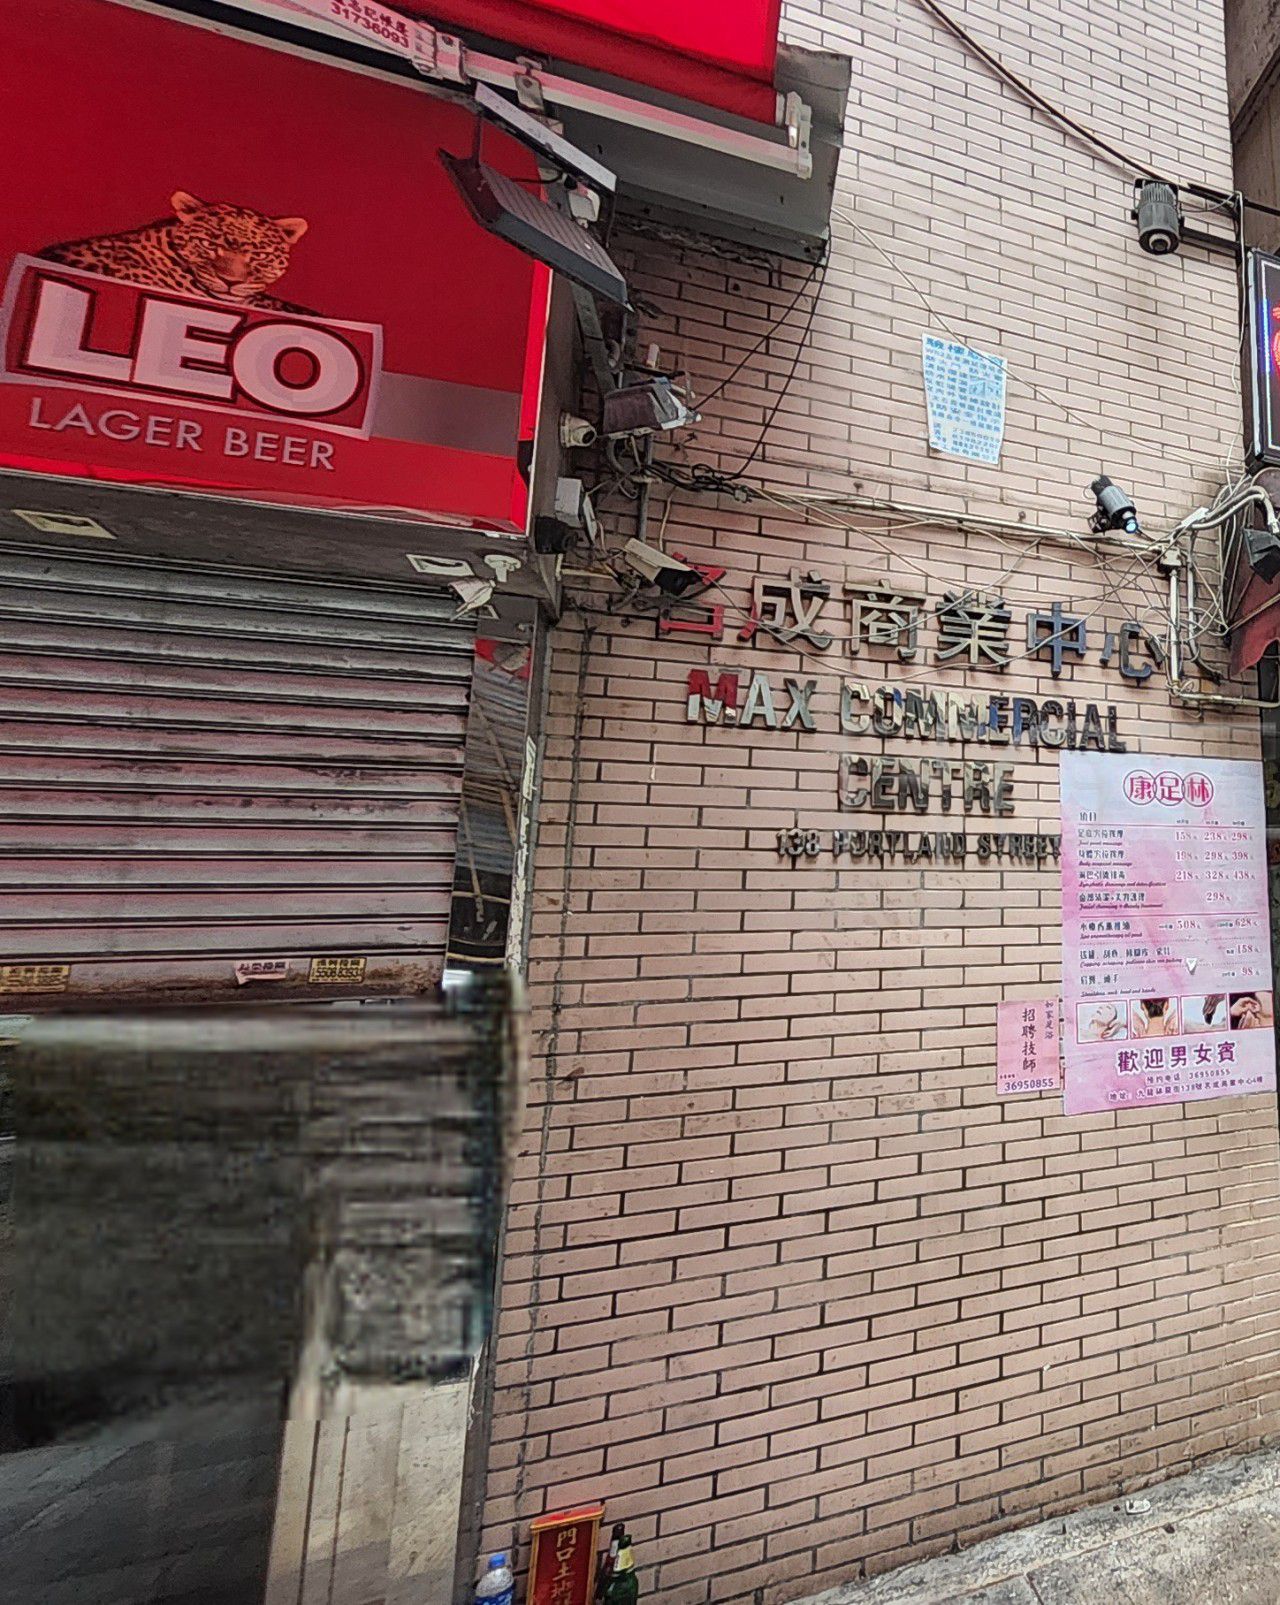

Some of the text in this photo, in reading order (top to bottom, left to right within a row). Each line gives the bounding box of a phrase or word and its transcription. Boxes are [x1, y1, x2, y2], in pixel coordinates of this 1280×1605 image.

[25, 278, 364, 416] LEO
[29, 397, 335, 471] LAGER BEER
[686, 668, 1127, 753] MAX COMMERCIAL
[838, 753, 1017, 815] CENTRE
[1128, 775, 1210, 803] 康足林
[775, 828, 821, 858] 138
[832, 829, 968, 861] PORTLAND
[1021, 1007, 1037, 1073] 招聘技師
[1117, 1040, 1237, 1074] 歡迎男女賓
[1004, 1077, 1055, 1092] 36950855
